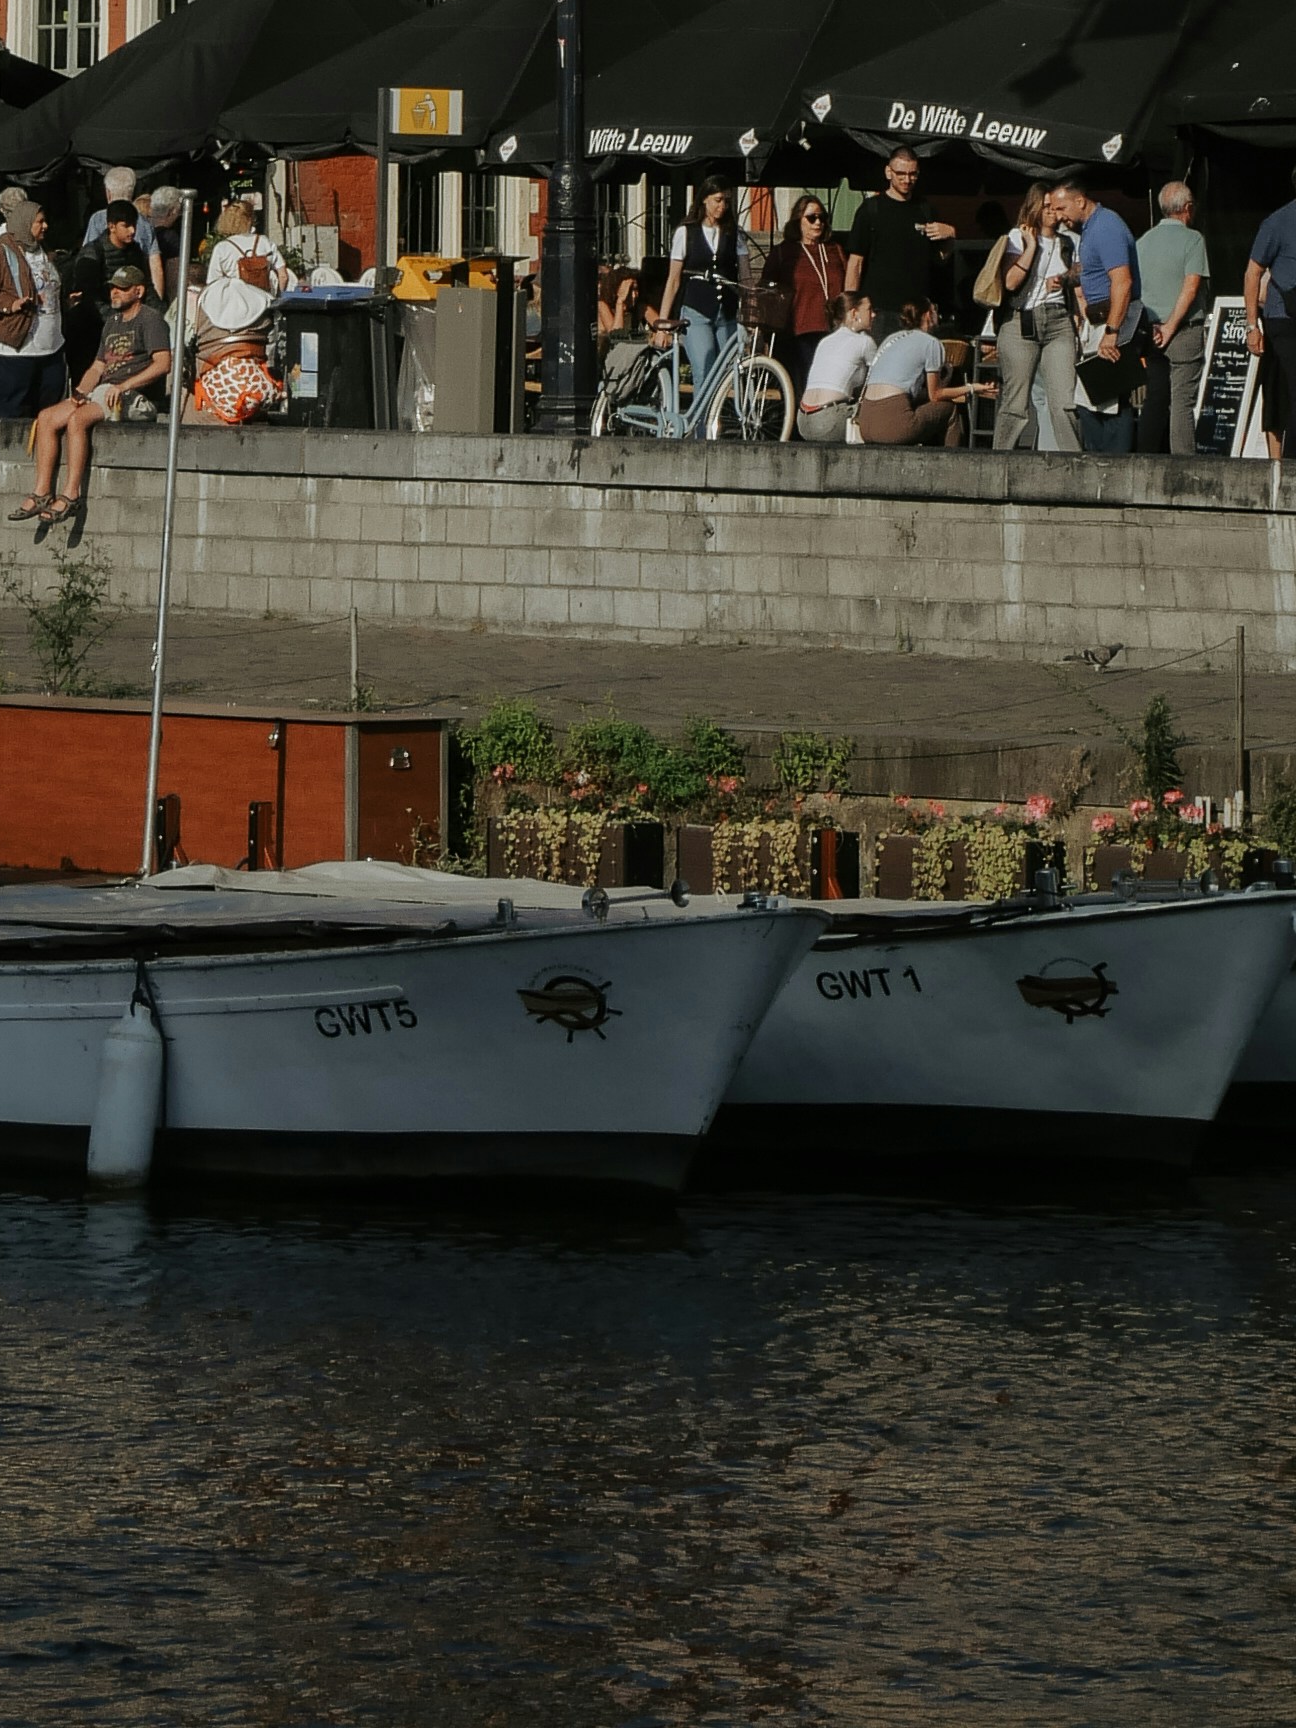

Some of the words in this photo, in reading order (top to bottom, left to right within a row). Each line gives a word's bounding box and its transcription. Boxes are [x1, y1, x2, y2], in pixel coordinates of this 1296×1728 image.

[587, 128, 626, 155] Witte
[627, 127, 693, 154] Leeuw
[888, 102, 916, 130] De
[919, 105, 966, 134] Witte
[969, 112, 1047, 149] Leeuw
[815, 968, 891, 1000] GWT
[903, 965, 922, 993] 1
[314, 1000, 418, 1038] GWT5
